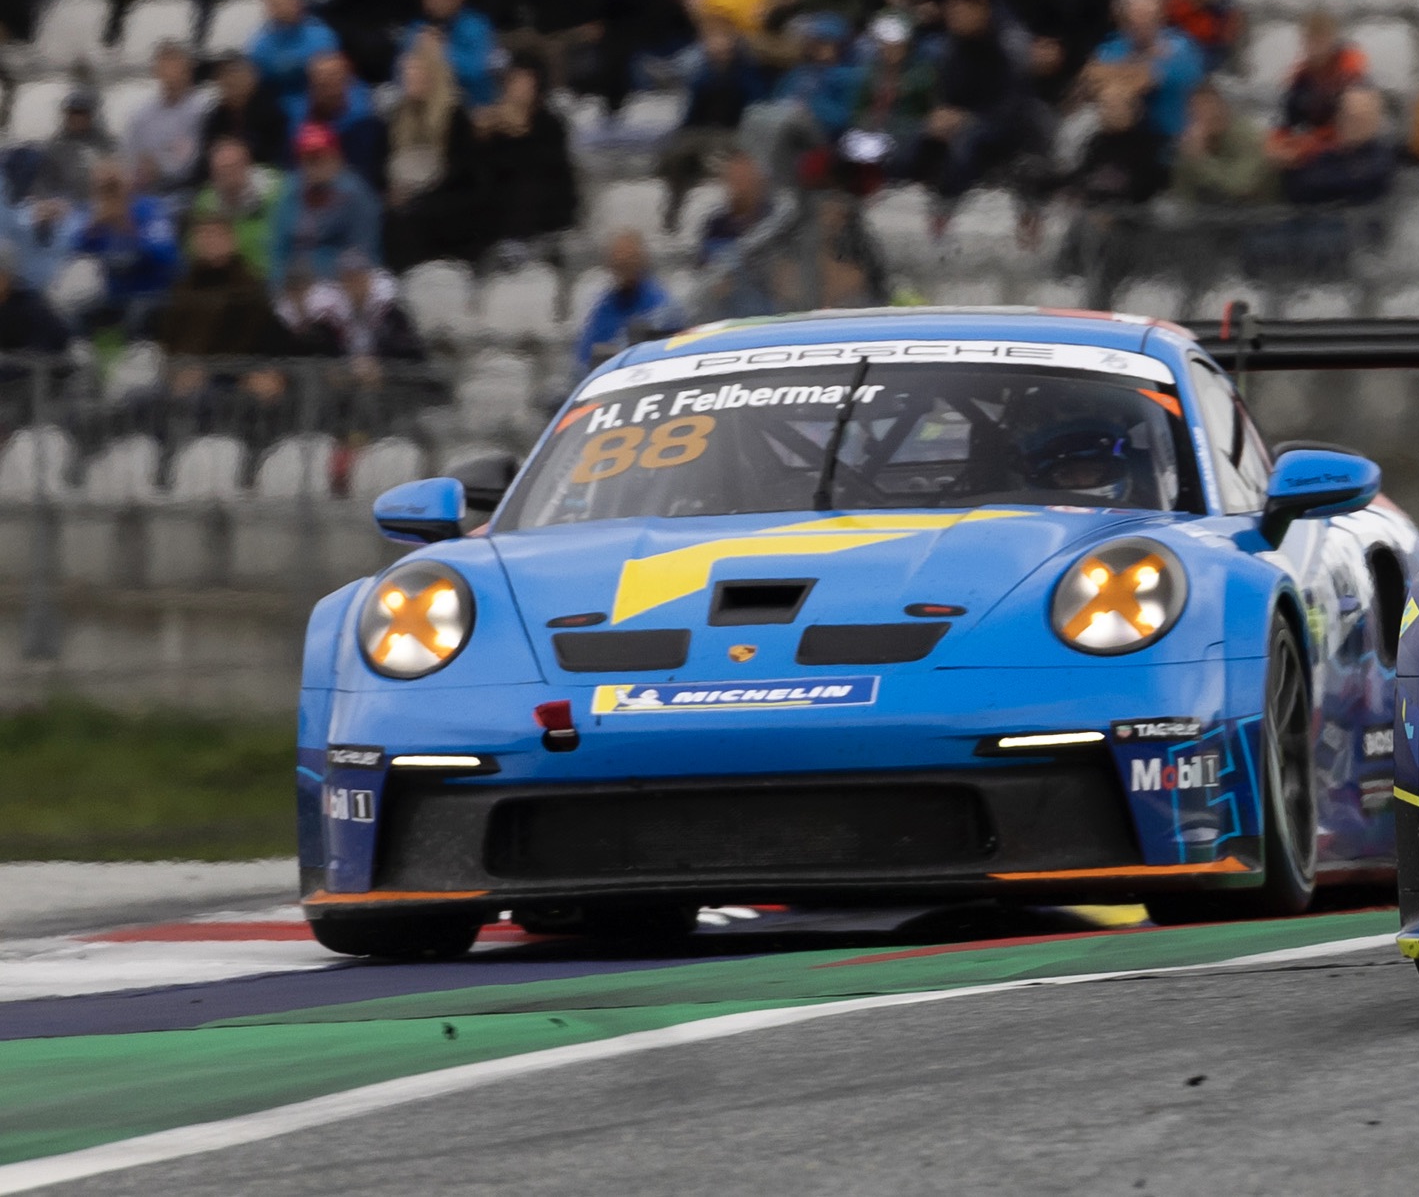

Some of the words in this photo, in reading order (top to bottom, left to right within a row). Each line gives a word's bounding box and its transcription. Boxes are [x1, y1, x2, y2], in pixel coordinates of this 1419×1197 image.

[695, 345, 1055, 371] PORSCHE
[587, 407, 622, 434] H.
[630, 395, 661, 421] F.
[670, 382, 885, 418] Felbermayr
[571, 415, 717, 484] 88
[671, 685, 852, 703] MICHELIN
[1131, 753, 1202, 792] Mobil
